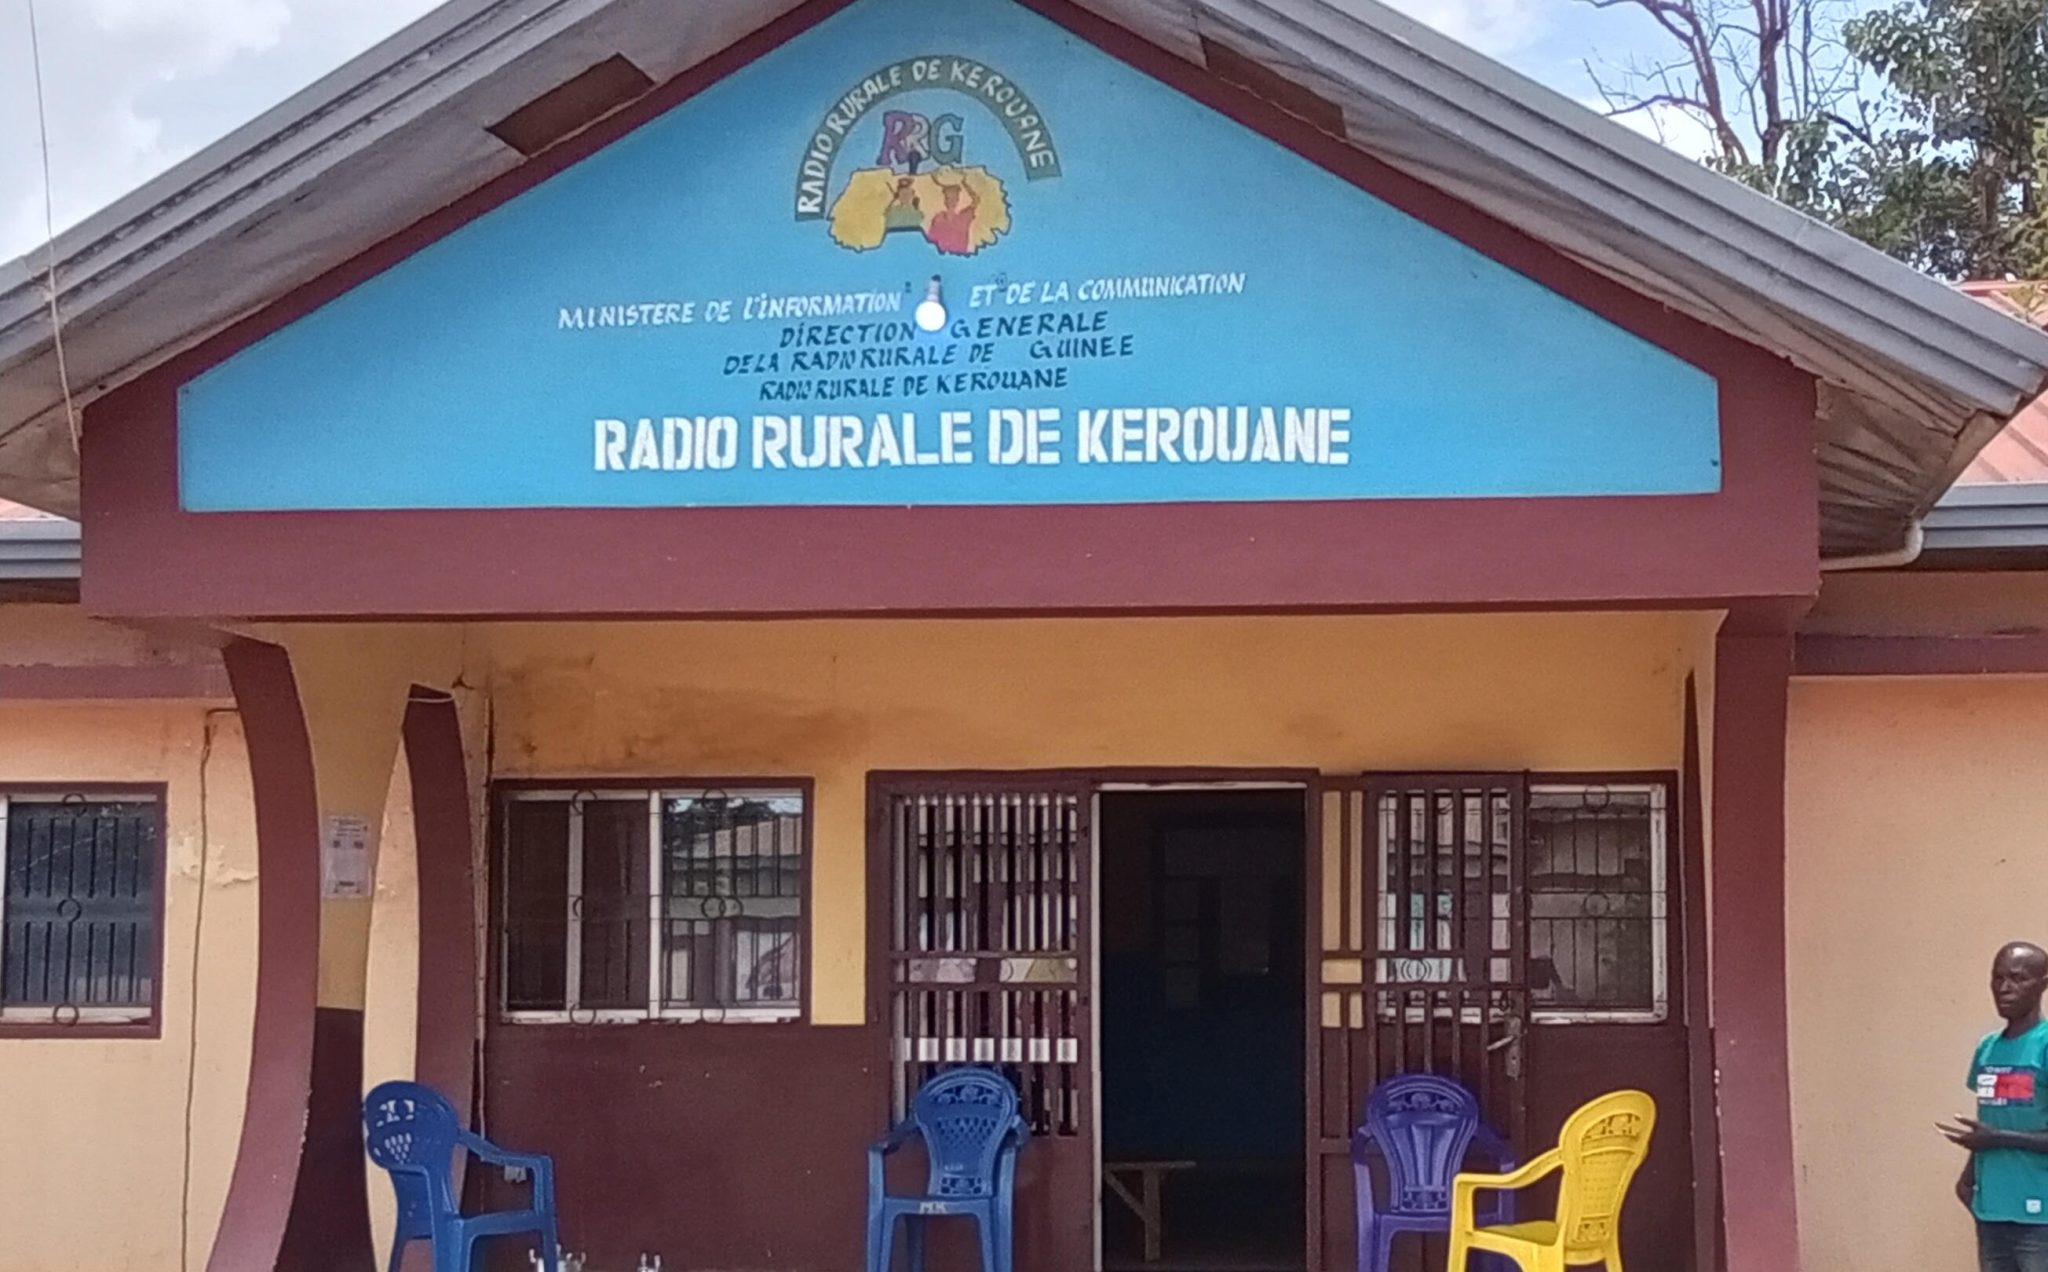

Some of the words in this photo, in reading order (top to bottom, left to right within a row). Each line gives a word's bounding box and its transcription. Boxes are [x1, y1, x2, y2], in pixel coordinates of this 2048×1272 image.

[796, 132, 834, 213] RADIO
[826, 65, 901, 136] RURALE
[912, 59, 942, 81] DE
[950, 60, 1055, 168] KEROUANE
[876, 110, 963, 166] RRG
[558, 301, 696, 330] MINISTERE
[704, 300, 732, 322] DE
[969, 284, 997, 307] ET
[1005, 280, 1036, 304] DE
[1041, 281, 1069, 303] LA
[1078, 272, 1246, 300] COMMUNICATION
[951, 311, 1108, 339] GENERALE
[968, 342, 995, 364] DE
[1029, 334, 1134, 359] GUINEE
[903, 375, 928, 397] DE
[937, 367, 1068, 393] KEROUANE
[594, 415, 738, 471] RADIO
[752, 411, 973, 468] RURALE
[988, 407, 1061, 465] DE
[1077, 406, 1351, 465] KEROUANE
